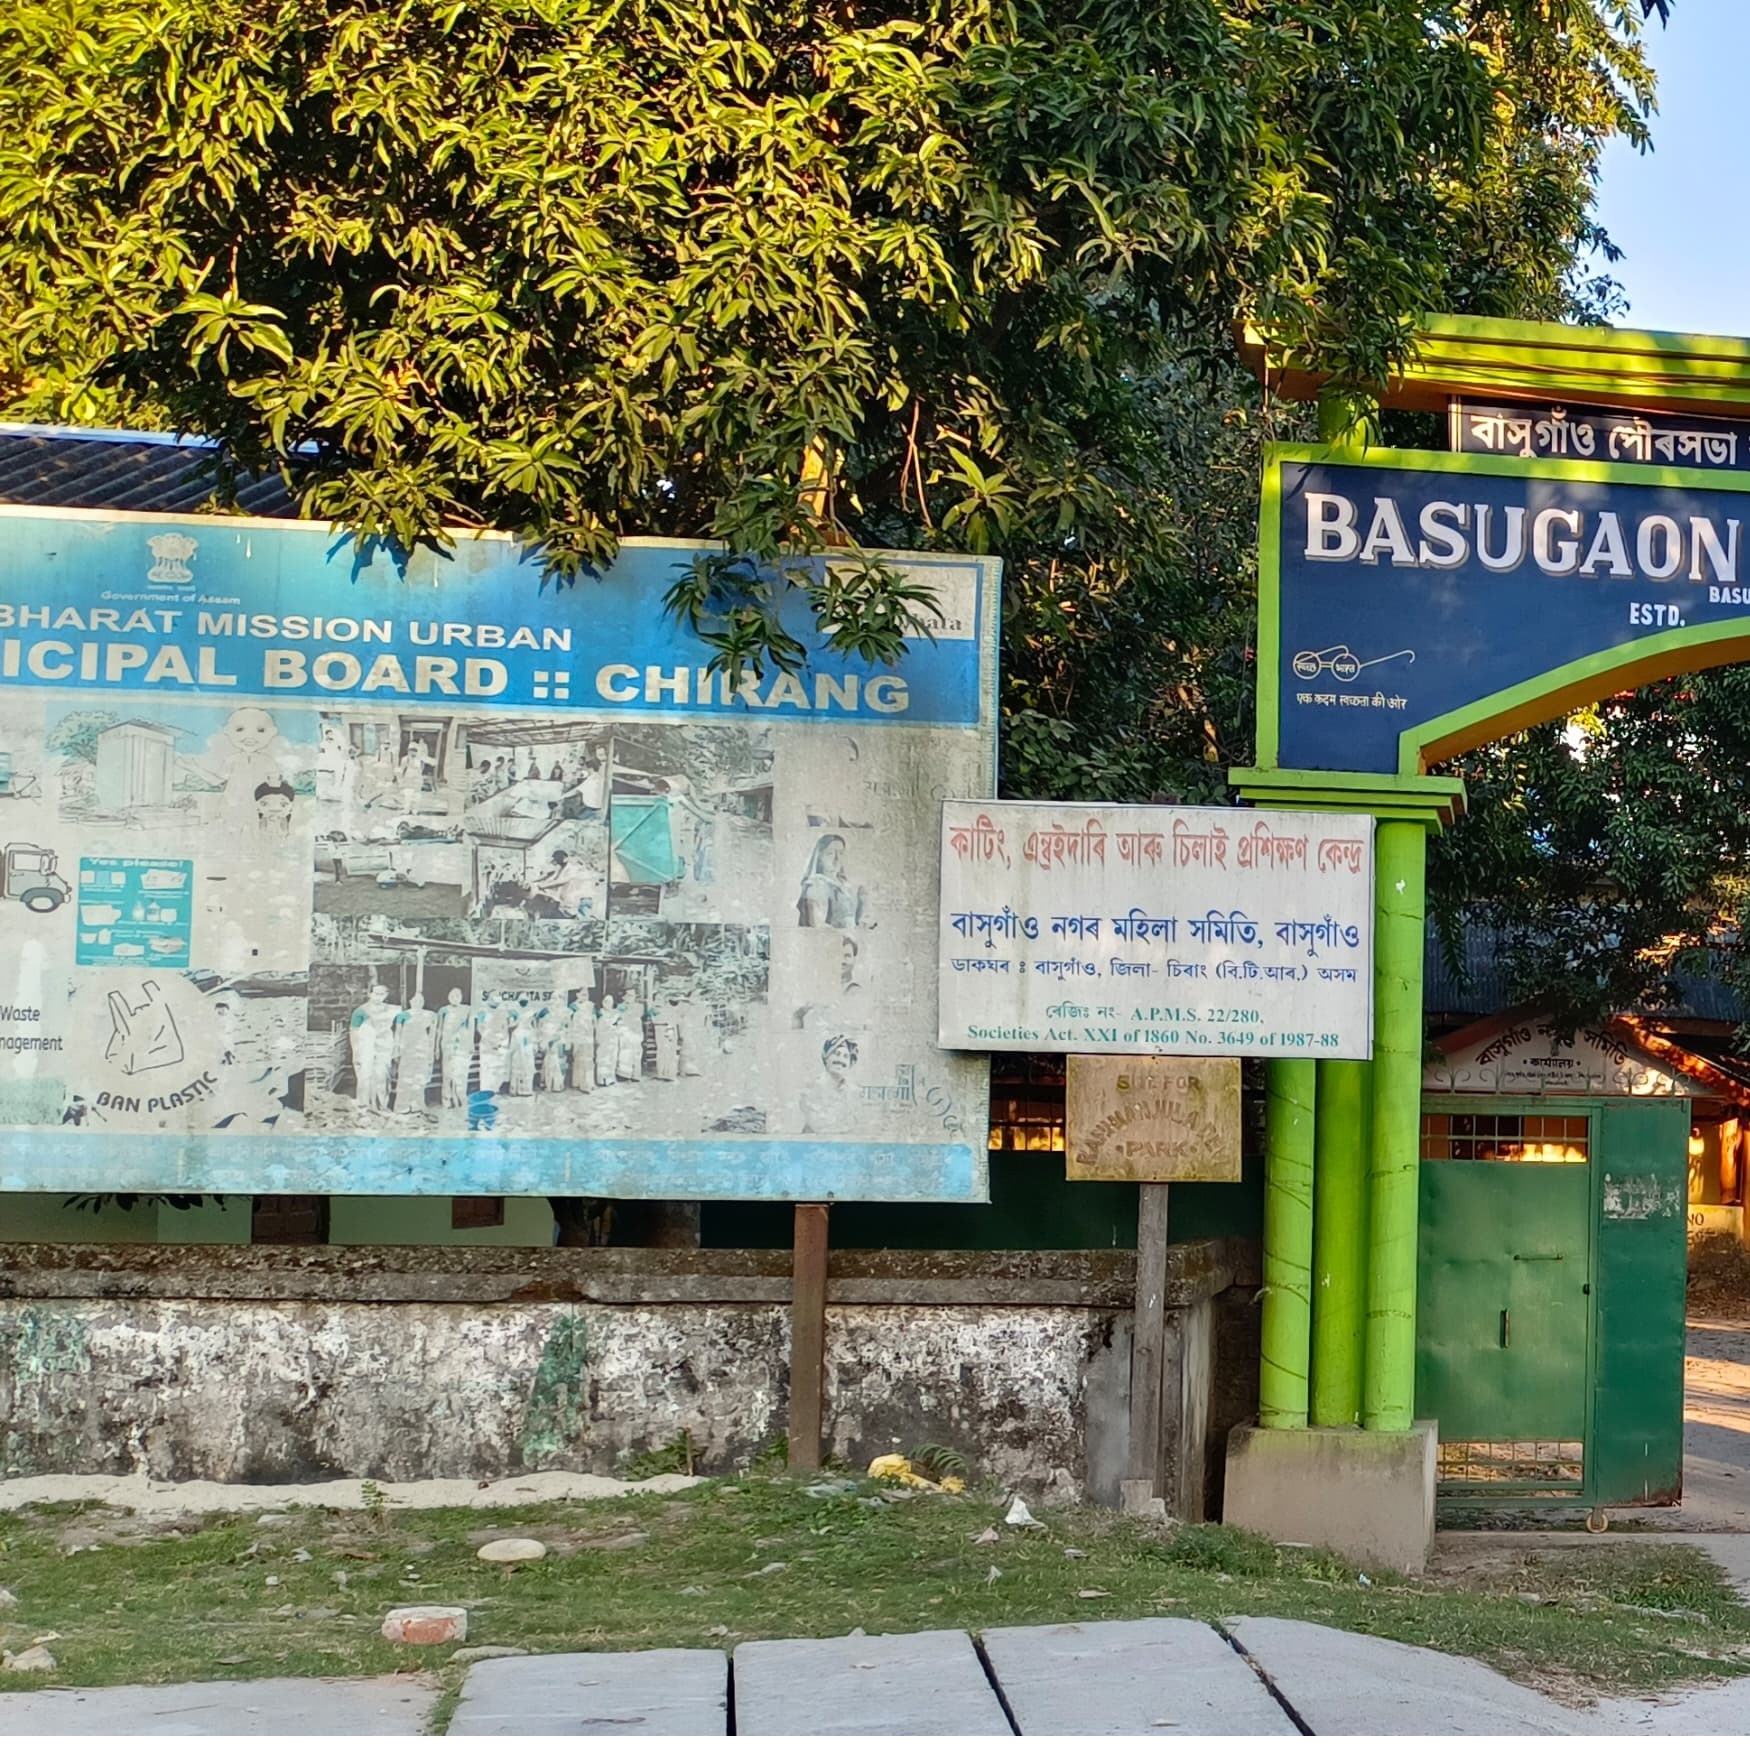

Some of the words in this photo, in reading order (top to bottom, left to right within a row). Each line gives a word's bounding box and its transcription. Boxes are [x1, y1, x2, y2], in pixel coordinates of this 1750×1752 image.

[1303, 491, 1741, 584] BASUGAON
[101, 590, 179, 602] Government
[182, 593, 196, 602] of
[1629, 602, 1686, 626] ESTD.
[0, 603, 182, 633] BHARAT
[197, 612, 393, 644] MISSION
[409, 621, 572, 652] URBAN
[3, 639, 238, 686] ICIPAL
[262, 649, 509, 696] BOARD
[595, 663, 909, 714] CHIRANG
[1371, 691, 1385, 709] की
[1173, 818, 1230, 871] চিলাই
[950, 905, 1040, 949] বাসুগাঁও
[1050, 914, 1102, 941] নগৰ
[1111, 908, 1178, 945] মহিলা
[1187, 910, 1263, 949] সমিতি,
[1274, 913, 1361, 958] বাসুগাঁও
[1317, 967, 1358, 983] অসম
[0, 1005, 41, 1021] Waste
[1130, 1007, 1201, 1022] A.P.M.S.
[967, 1025, 1039, 1041] Societies
[1044, 1027, 1077, 1042] Act.
[1084, 1028, 1117, 1043] XXI
[1123, 1028, 1141, 1043] of
[1144, 1029, 1180, 1044] 1860
[1185, 1030, 1212, 1044] No.
[1217, 1031, 1255, 1045] 3649
[1259, 1032, 1277, 1046] of
[1280, 1033, 1340, 1048] 1987-88
[96, 1091, 141, 1113] BAN
[147, 1071, 218, 1113] PLASTIC
[1163, 1074, 1202, 1091] FOR
